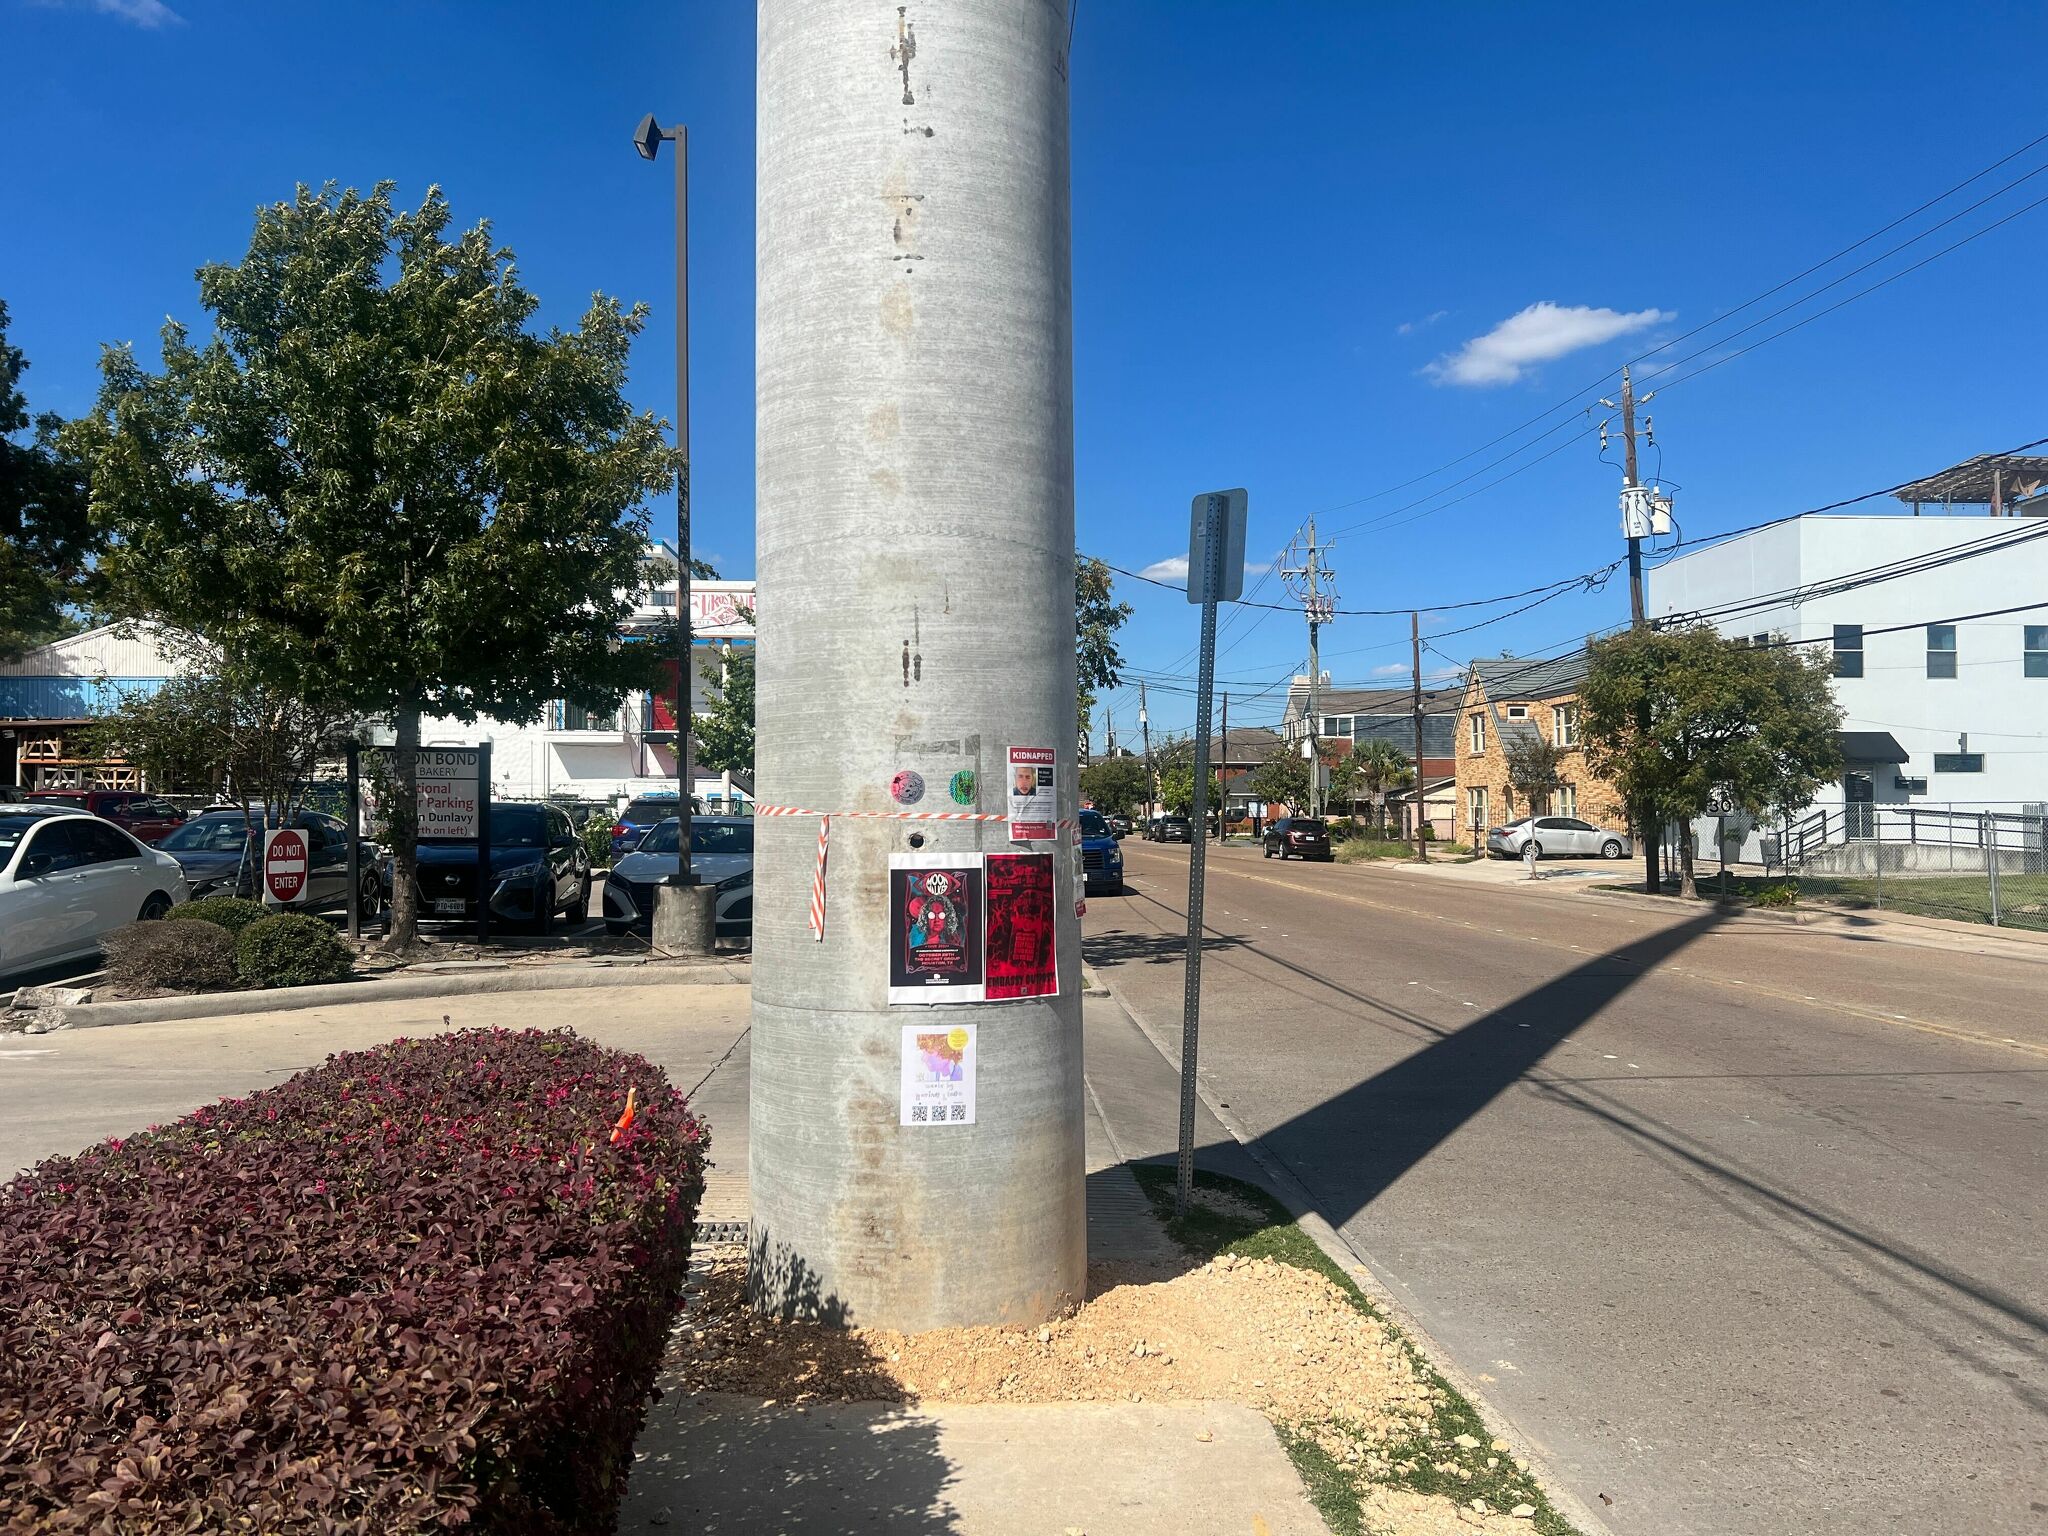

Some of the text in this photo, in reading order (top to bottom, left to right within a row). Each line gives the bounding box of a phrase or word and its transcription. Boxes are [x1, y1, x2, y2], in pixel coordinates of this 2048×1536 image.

[435, 753, 477, 766] BOND
[1012, 751, 1053, 761] KIDNAPPED
[420, 767, 458, 776] BAKERY
[427, 797, 474, 812] Parking
[1709, 799, 1732, 812] 30
[428, 812, 473, 824] Dunlavy
[433, 827, 445, 835] on
[447, 825, 468, 836] left)
[272, 844, 301, 857] DO NOT
[274, 876, 298, 889] ENTER
[926, 873, 949, 886] MOON
